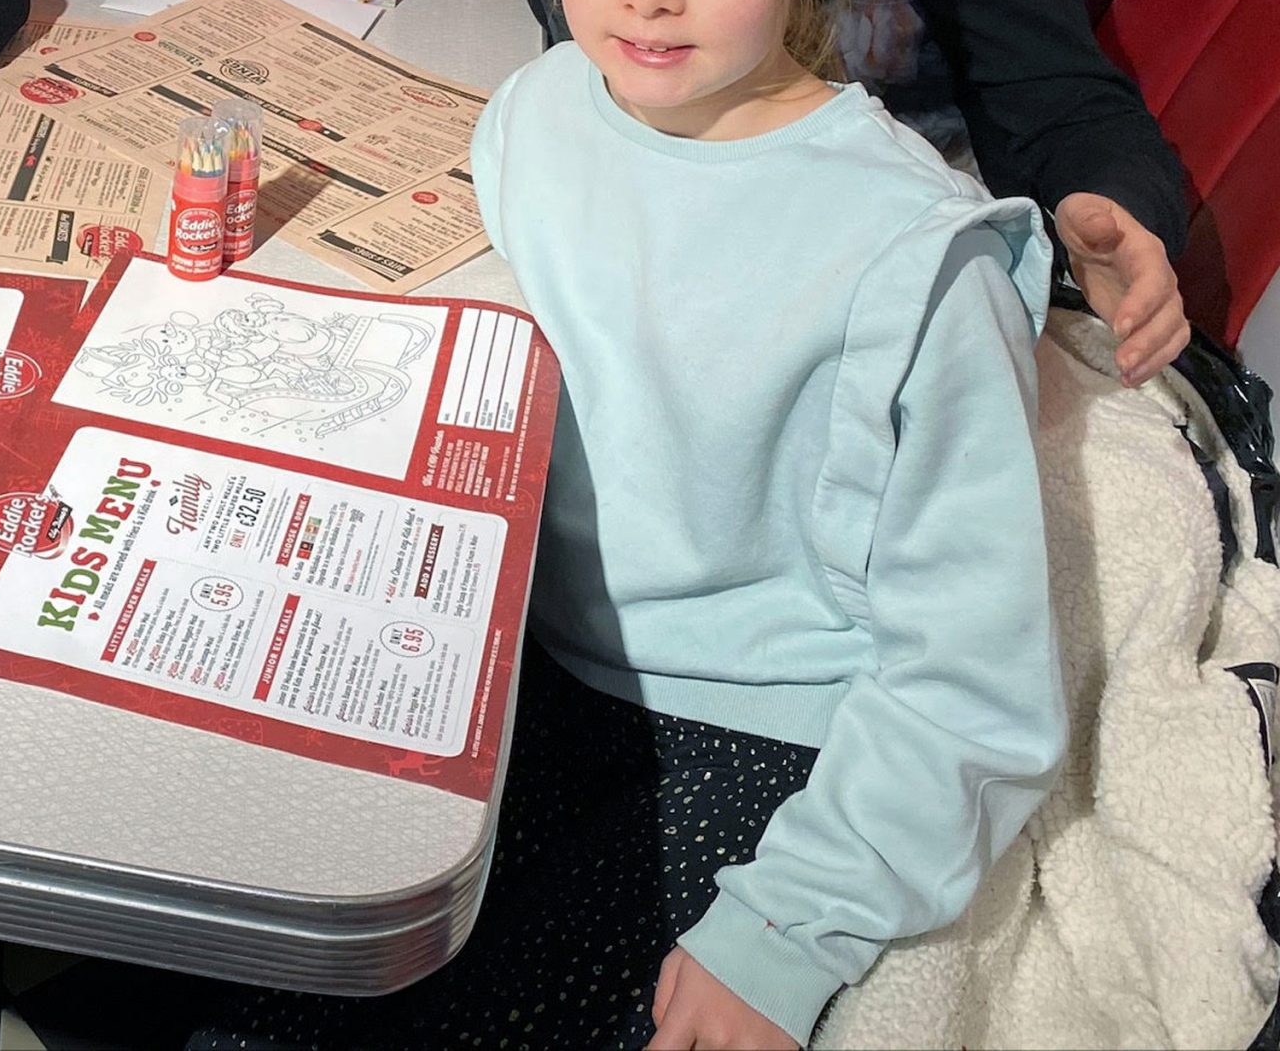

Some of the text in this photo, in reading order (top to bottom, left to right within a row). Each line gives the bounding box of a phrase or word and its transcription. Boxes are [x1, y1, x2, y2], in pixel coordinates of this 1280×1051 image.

[215, 57, 270, 86] WINGS
[182, 219, 216, 231] Eddie
[350, 245, 377, 260] SIDES
[380, 257, 407, 272] BITES
[2, 357, 23, 393] Eddie
[143, 489, 156, 503] drink
[166, 472, 212, 535] Family
[198, 496, 213, 520] SPECIAL
[137, 503, 150, 515] Kids
[210, 476, 246, 552] TWO LITTLE HELPER MEALS
[229, 488, 265, 547] ONLY €32.50
[12, 494, 50, 558] Rocket's
[126, 525, 140, 538] fries
[203, 535, 211, 548] ANY
[208, 520, 218, 533] TWO
[215, 500, 226, 519] ADULT
[281, 529, 296, 557] CHOOSE
[294, 500, 306, 520] DRINK
[37, 548, 108, 632] KIDS
[79, 457, 152, 545] MENU
[122, 539, 134, 551] with
[390, 557, 403, 575] Cream
[401, 527, 411, 538] Kids
[113, 551, 128, 571] served
[419, 533, 439, 588] ADD A DESSERT
[108, 571, 119, 581] are
[100, 582, 114, 600] meals
[199, 583, 212, 598] ONLY
[210, 583, 233, 606] 5.95
[93, 600, 105, 609] All
[107, 624, 125, 652] LITTLE
[120, 594, 138, 623] HELPER
[133, 568, 150, 592] MEALS
[262, 608, 293, 683] JUNIOR ELF MEALS
[389, 628, 402, 644] ONLY
[401, 627, 423, 652] 6.95
